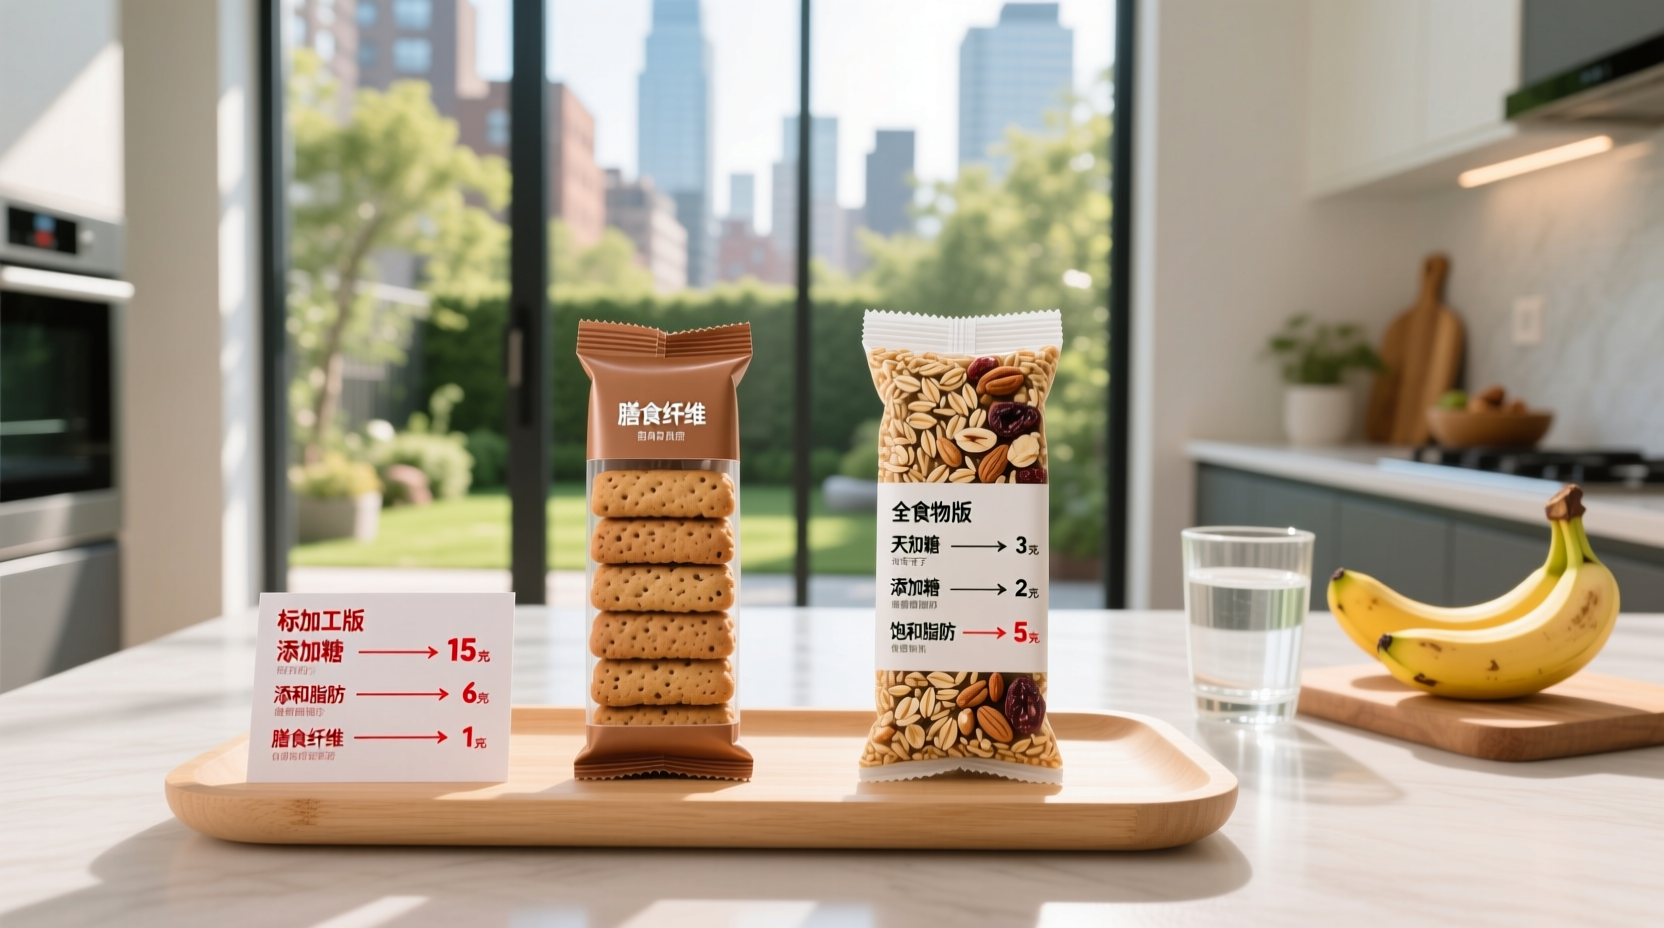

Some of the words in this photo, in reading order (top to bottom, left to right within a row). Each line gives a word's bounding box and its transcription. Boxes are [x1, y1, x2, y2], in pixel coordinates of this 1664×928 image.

[618, 401, 706, 426] 膳食纤维
[892, 501, 972, 523] 全食物版
[891, 578, 940, 597] 添加糖
[277, 609, 364, 632] 标加工版
[890, 621, 956, 641] 饱和脂肪
[277, 639, 343, 663] 添加糖
[272, 728, 343, 748] 膳食纤维
